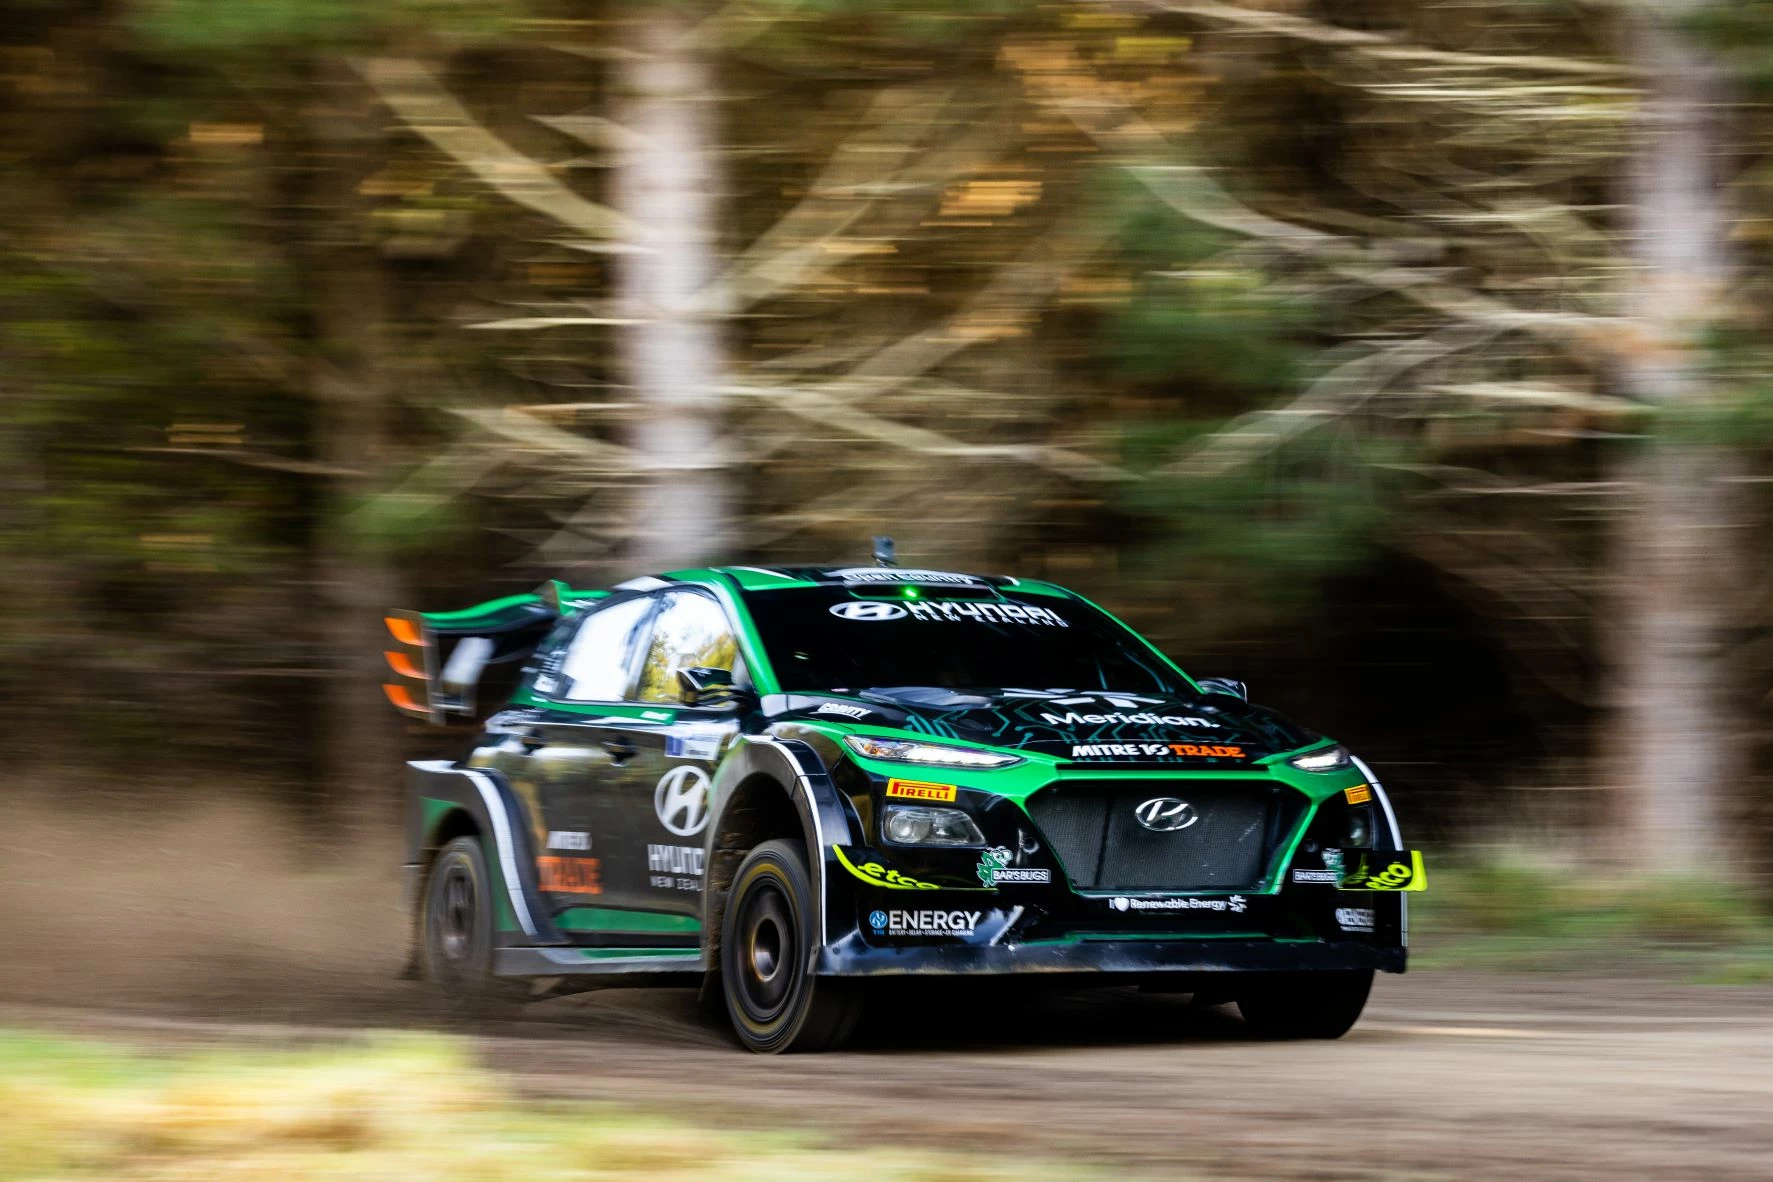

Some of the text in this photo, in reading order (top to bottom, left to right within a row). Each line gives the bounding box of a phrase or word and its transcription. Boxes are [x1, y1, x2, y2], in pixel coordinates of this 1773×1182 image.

[904, 600, 1062, 622] HYUNDAI
[817, 702, 873, 718] GRAVITY
[1072, 743, 1246, 758] MITRE 10 TRADE
[891, 782, 950, 800] PIRELLI
[1130, 898, 1189, 909] Renewable
[1189, 898, 1228, 911] Energy
[889, 910, 982, 930] ENERGY
